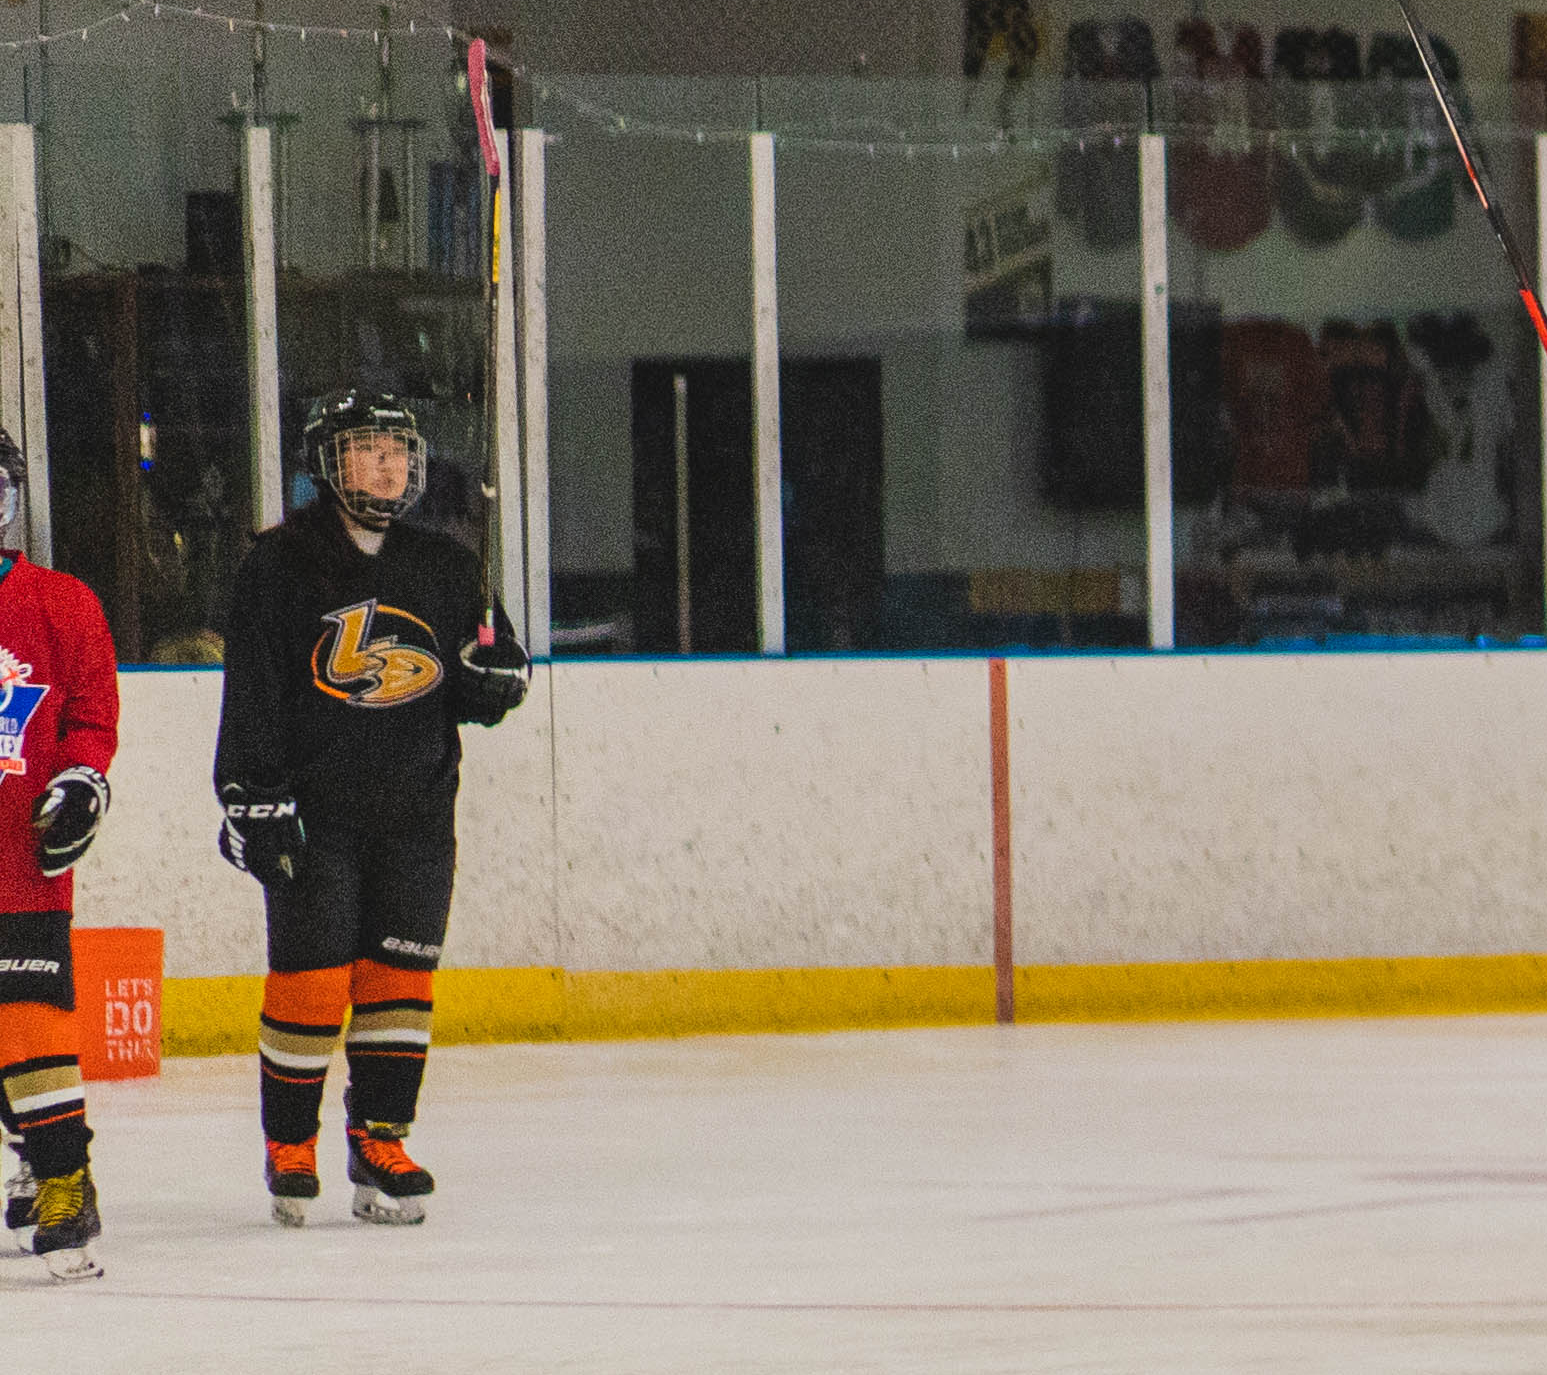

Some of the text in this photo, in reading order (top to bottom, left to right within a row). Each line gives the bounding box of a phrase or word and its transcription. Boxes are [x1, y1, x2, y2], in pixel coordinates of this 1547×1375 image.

[227, 798, 297, 819] CCM
[0, 958, 60, 975] AUER
[105, 1000, 153, 1036] DO
